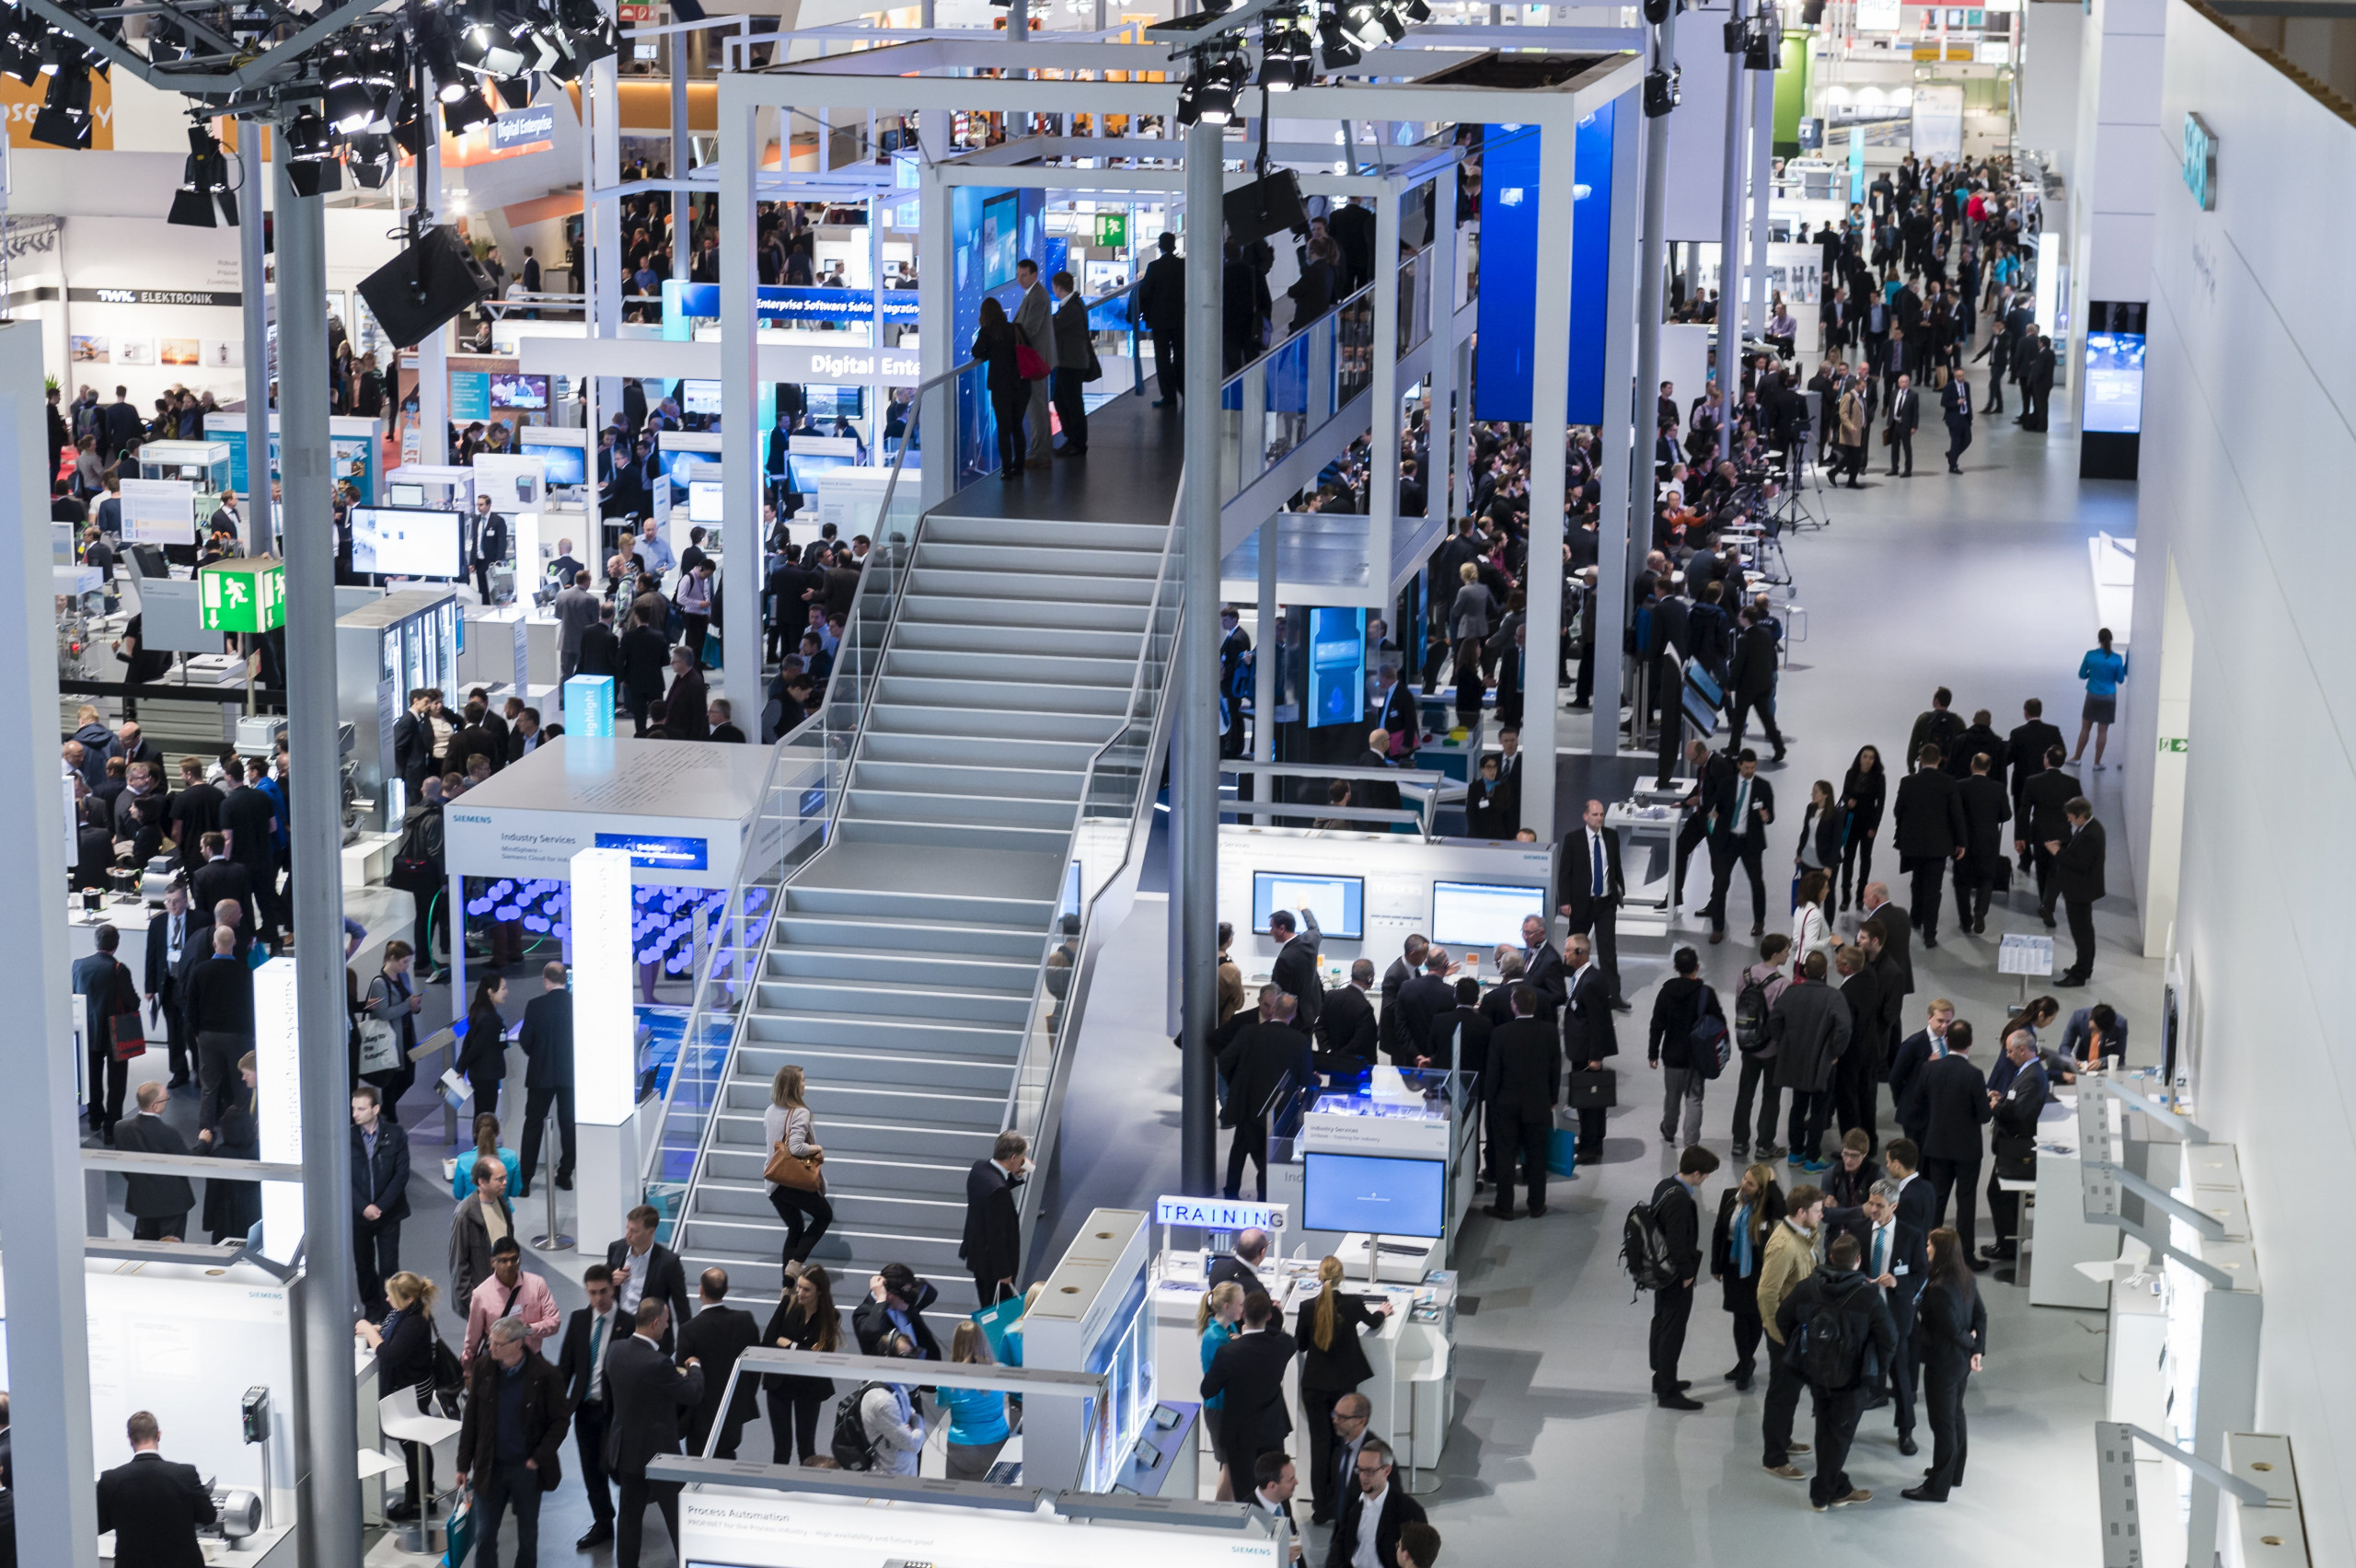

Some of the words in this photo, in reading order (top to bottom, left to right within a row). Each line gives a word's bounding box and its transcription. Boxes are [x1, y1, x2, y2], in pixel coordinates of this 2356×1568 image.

[497, 118, 520, 142] Digital
[520, 114, 553, 136] Enterprise
[96, 289, 136, 303] TWK
[140, 292, 213, 305] ELEKTRONIK
[756, 299, 803, 311] Enterprise
[803, 299, 847, 312] Software
[848, 300, 873, 313] Suite
[883, 303, 920, 316] tegratin
[811, 355, 874, 377] Digital
[881, 358, 920, 376] Ente
[453, 814, 492, 824] SIEMENS
[501, 832, 537, 844] Industry
[539, 834, 577, 845] Services
[1285, 1170, 1304, 1183] Ind
[1162, 1204, 1284, 1228] TRAINING
[248, 1291, 283, 1301] SIEMENS
[687, 1505, 726, 1518] Process
[728, 1509, 790, 1523] Automation
[1231, 1545, 1271, 1556] SIEMENS
